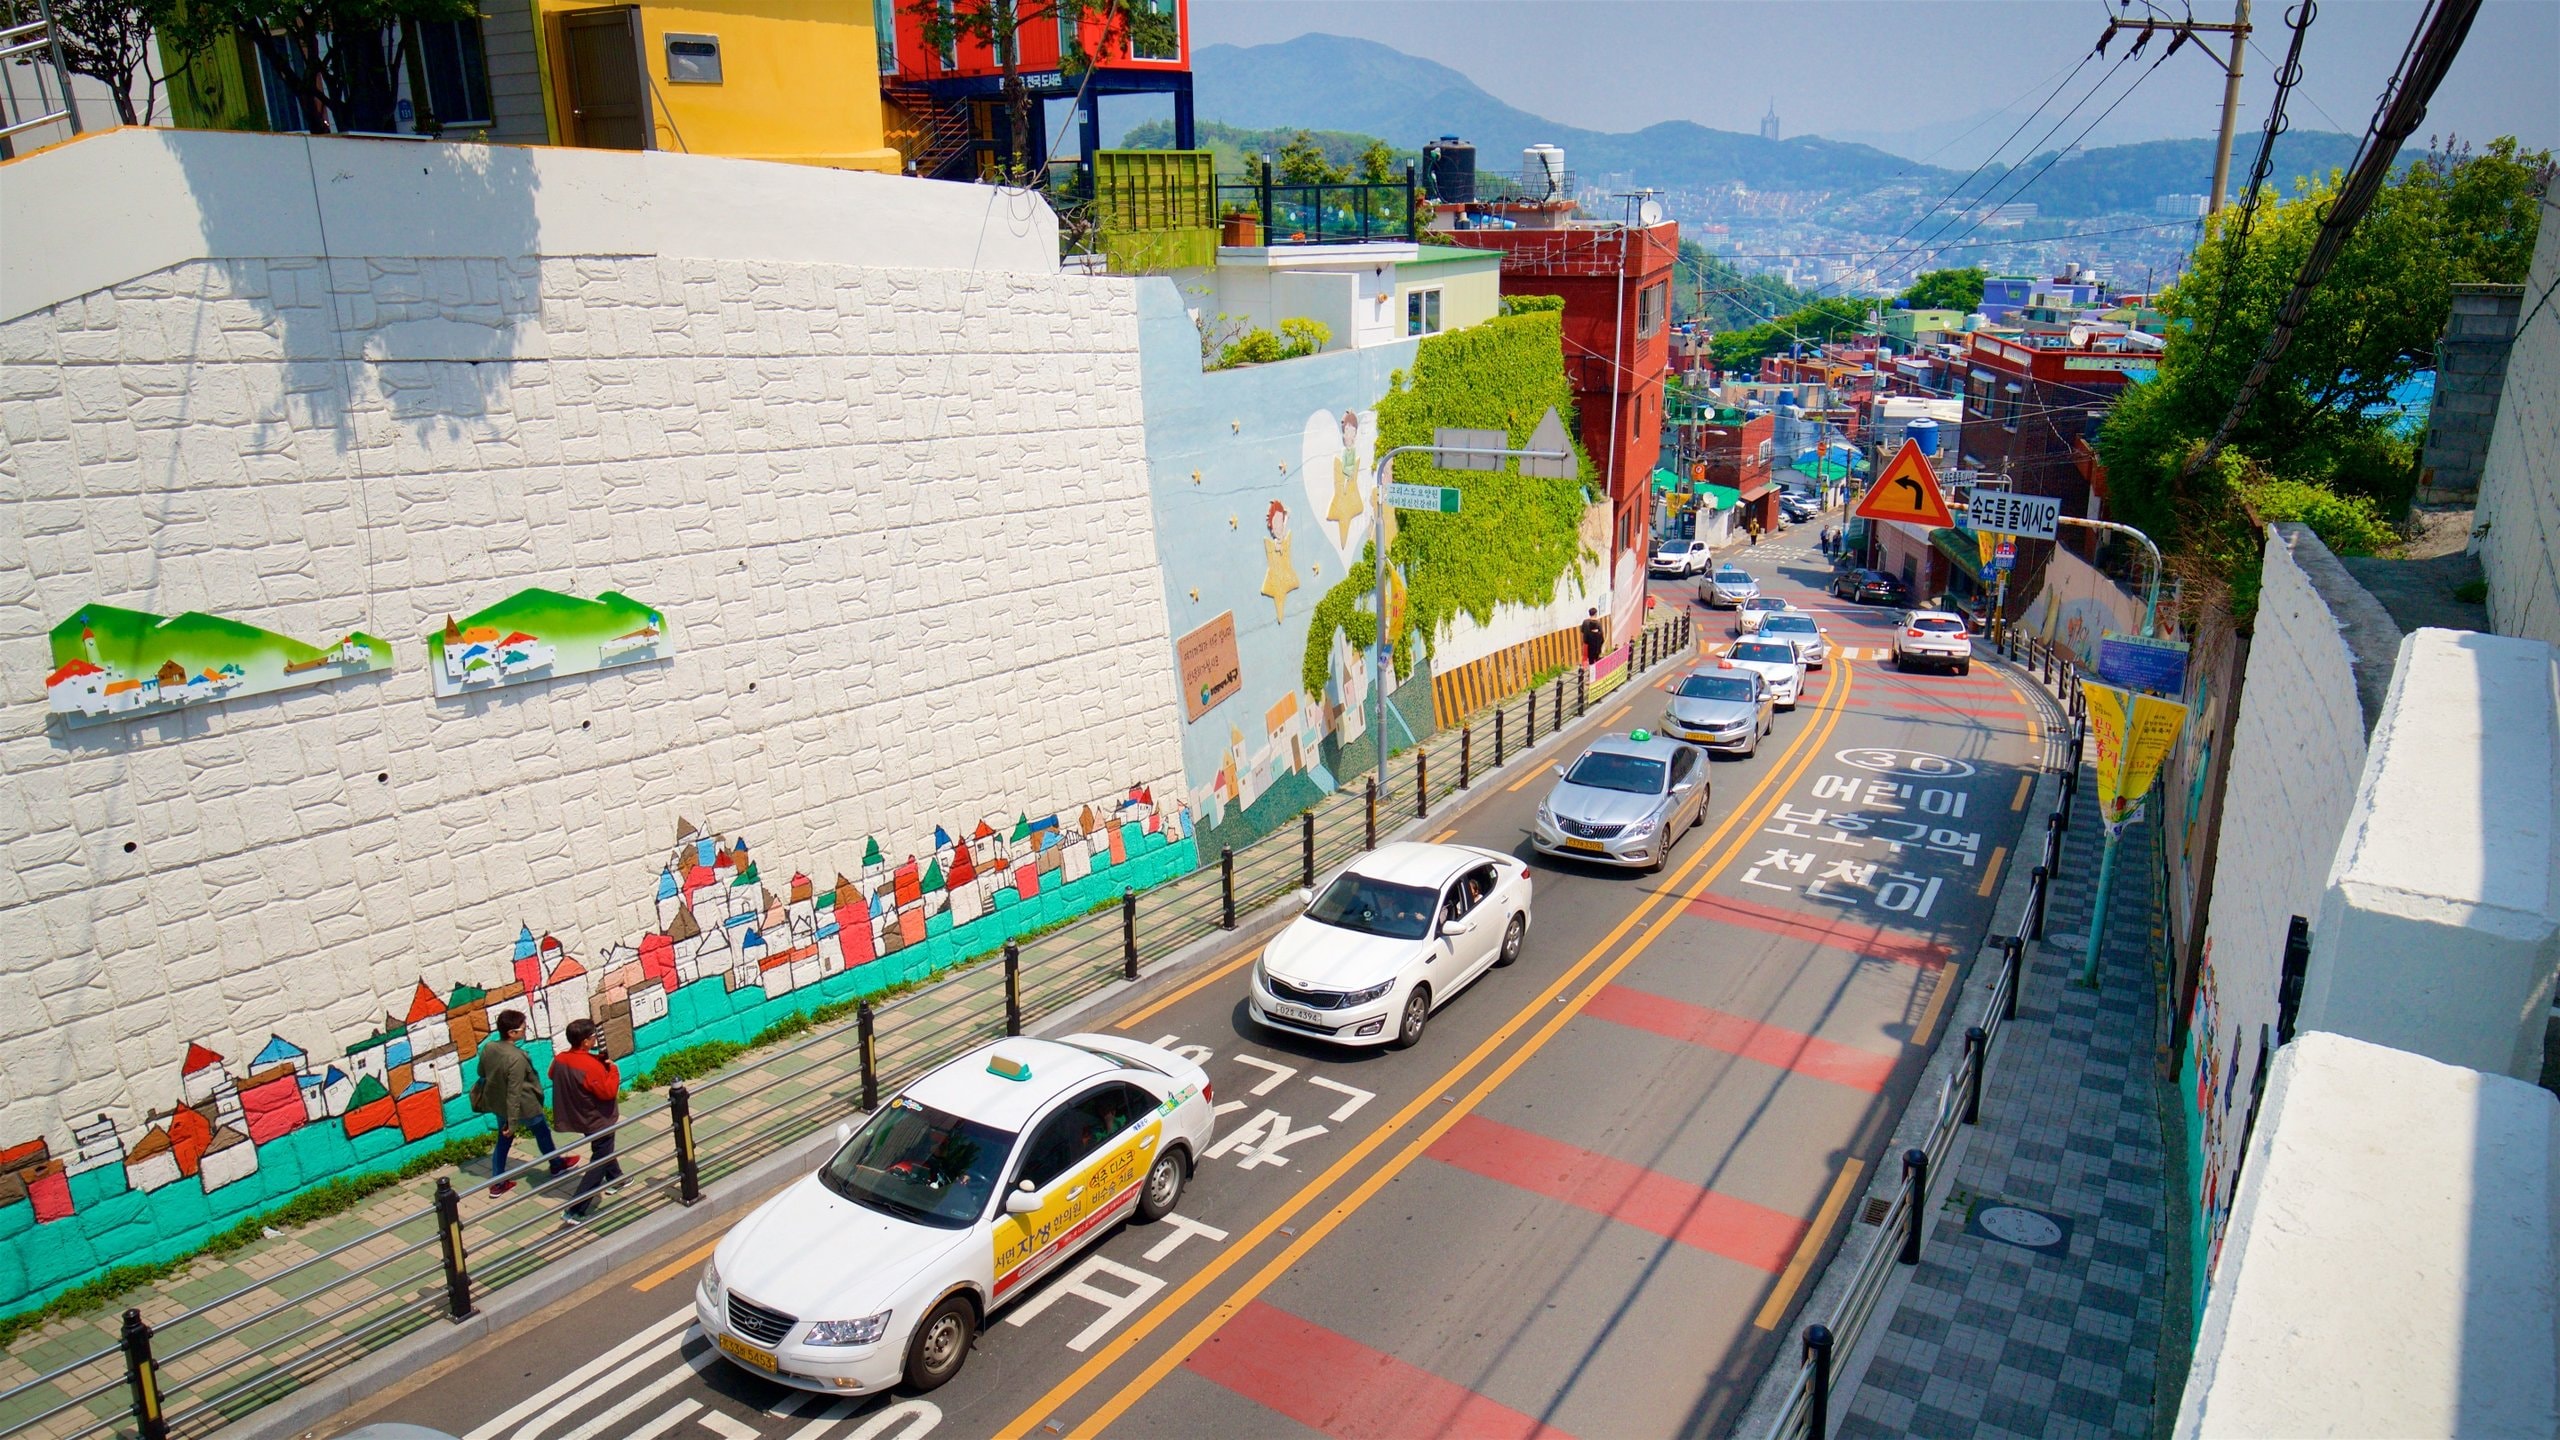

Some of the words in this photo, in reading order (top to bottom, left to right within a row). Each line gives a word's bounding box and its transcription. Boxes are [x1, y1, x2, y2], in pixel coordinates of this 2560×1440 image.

[1854, 751, 1953, 774] 30
[1811, 774, 1968, 819] 어린이
[1764, 802, 1983, 867] 보호구역
[1739, 847, 1944, 918] 천천히
[1090, 1168, 1108, 1188] 척추
[1109, 1152, 1135, 1174] 디스크
[1092, 1181, 1117, 1204] 비수술
[1118, 1167, 1134, 1184] 치료
[995, 1247, 1016, 1269] 서면
[1017, 1221, 1052, 1259] 자생
[1053, 1201, 1082, 1231] 한의원
[748, 1350, 771, 1368] 5453
